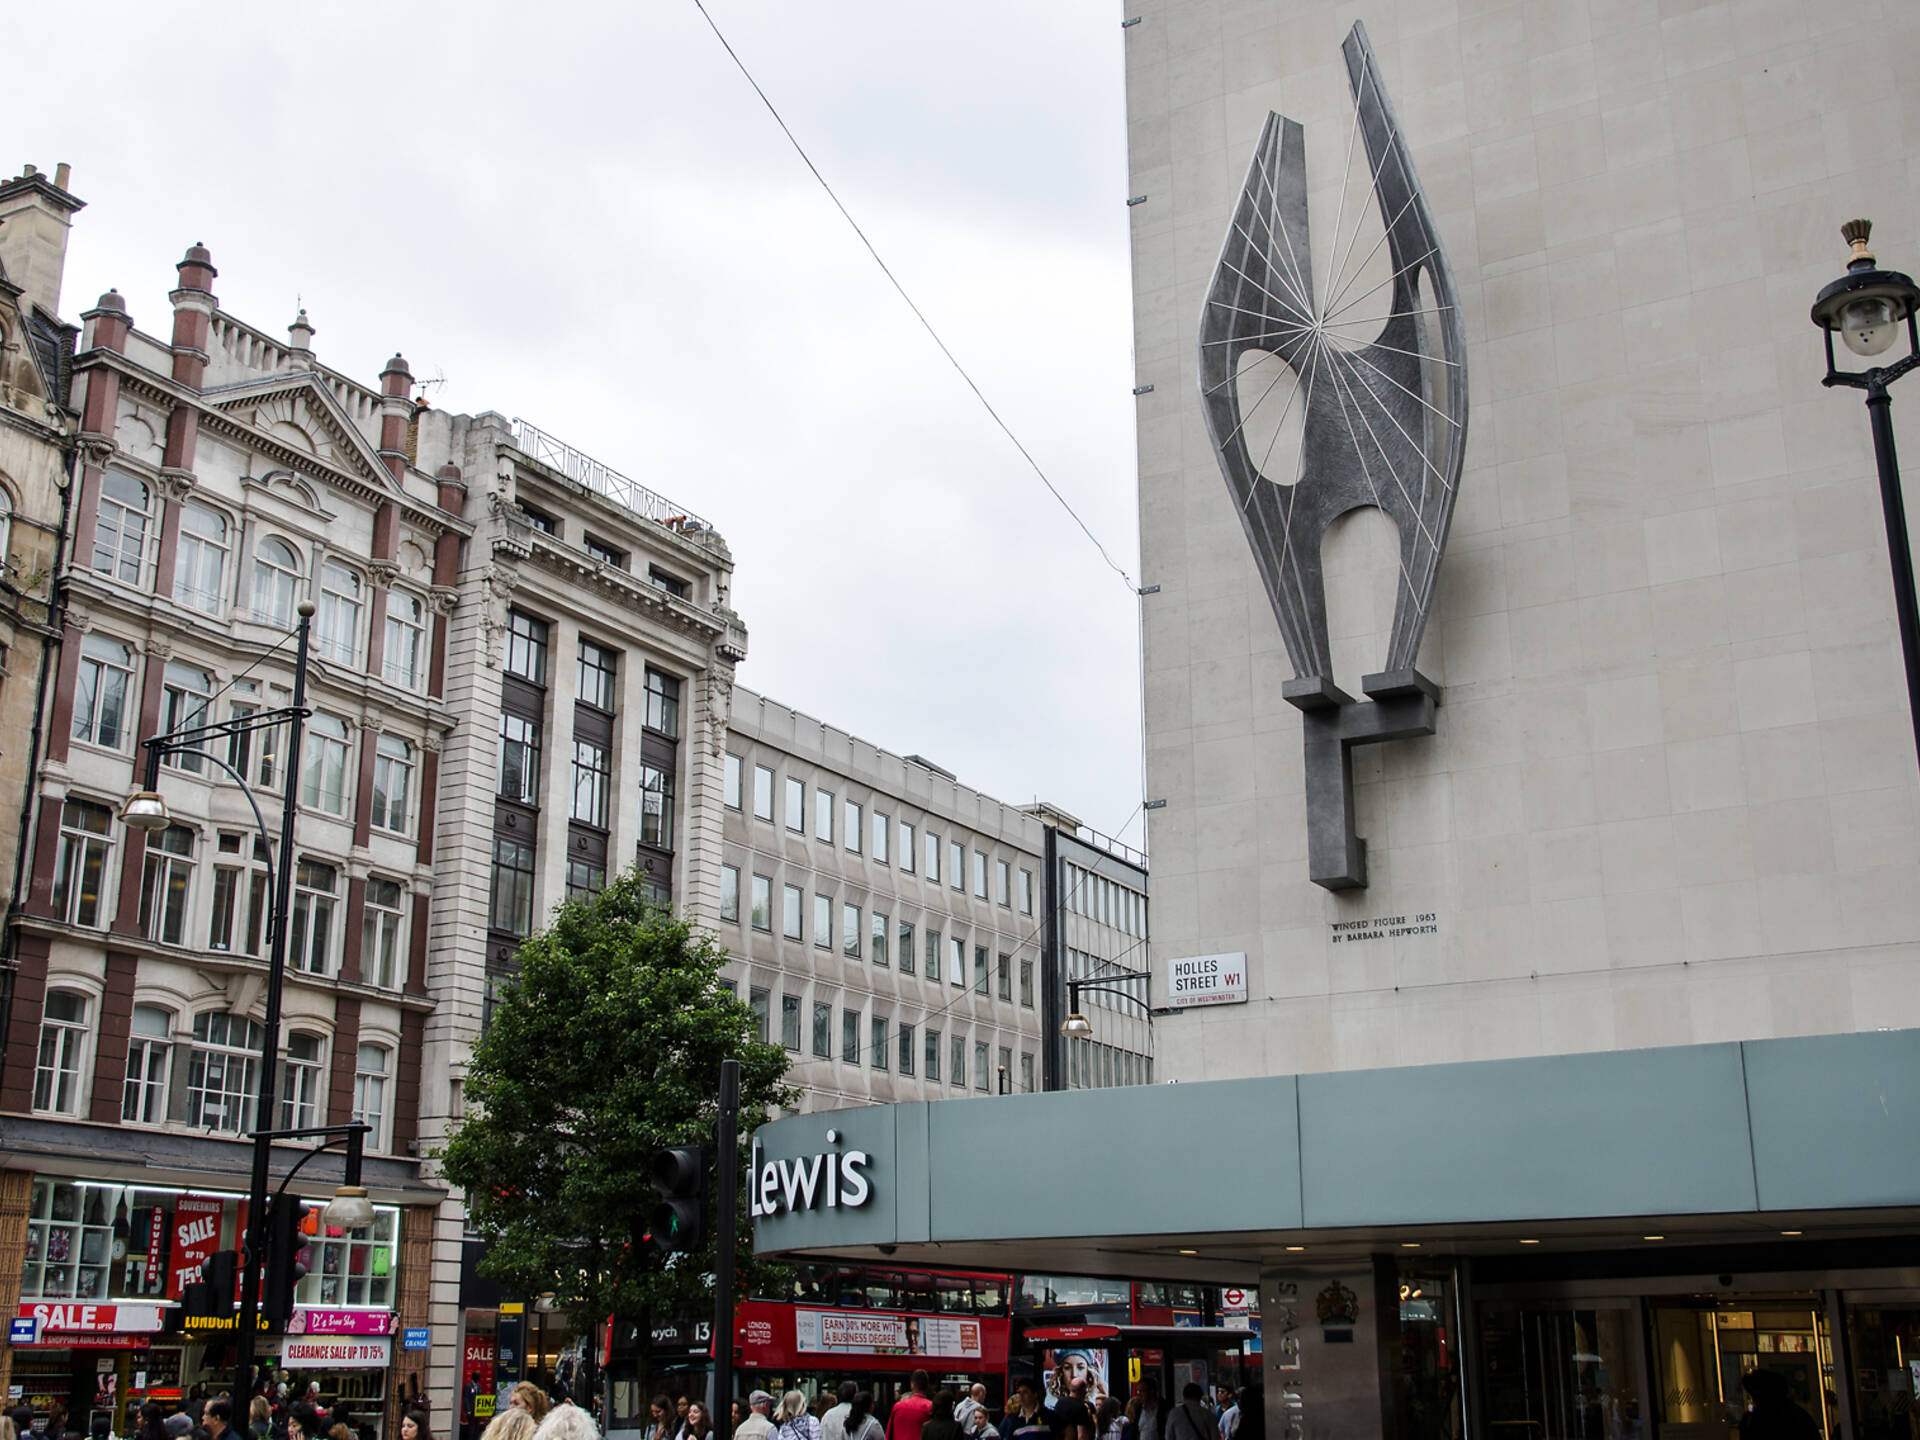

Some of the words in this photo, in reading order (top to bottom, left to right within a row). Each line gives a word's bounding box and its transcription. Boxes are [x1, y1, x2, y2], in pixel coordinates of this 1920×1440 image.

[1331, 920, 1369, 931] WINGED
[1374, 916, 1406, 927] FIGURE
[1415, 913, 1436, 922] 1963
[1332, 935, 1342, 943] BY
[1347, 930, 1385, 942] BARBARA
[1389, 924, 1438, 937] HEPWORTH
[1175, 960, 1218, 976] HOLLES
[1176, 975, 1218, 991] STREET
[1224, 972, 1241, 986] W1
[178, 1216, 216, 1247] SALE
[33, 1304, 97, 1330] SALE
[695, 1321, 711, 1340] 13
[748, 1321, 771, 1330] LONDON
[824, 1319, 844, 1329] EARN
[860, 1321, 881, 1332] MORE
[882, 1322, 903, 1333] WITH
[748, 1330, 772, 1338] UNITED
[825, 1331, 831, 1341] A
[832, 1331, 867, 1343] BUSINESS
[868, 1333, 896, 1345] DEGREE
[287, 1344, 328, 1360] CLEARANCE
[330, 1344, 346, 1360] SALE
[347, 1345, 358, 1360] UP
[359, 1346, 368, 1360] TO
[369, 1345, 384, 1360] 75%
[466, 1347, 494, 1360] SALE
